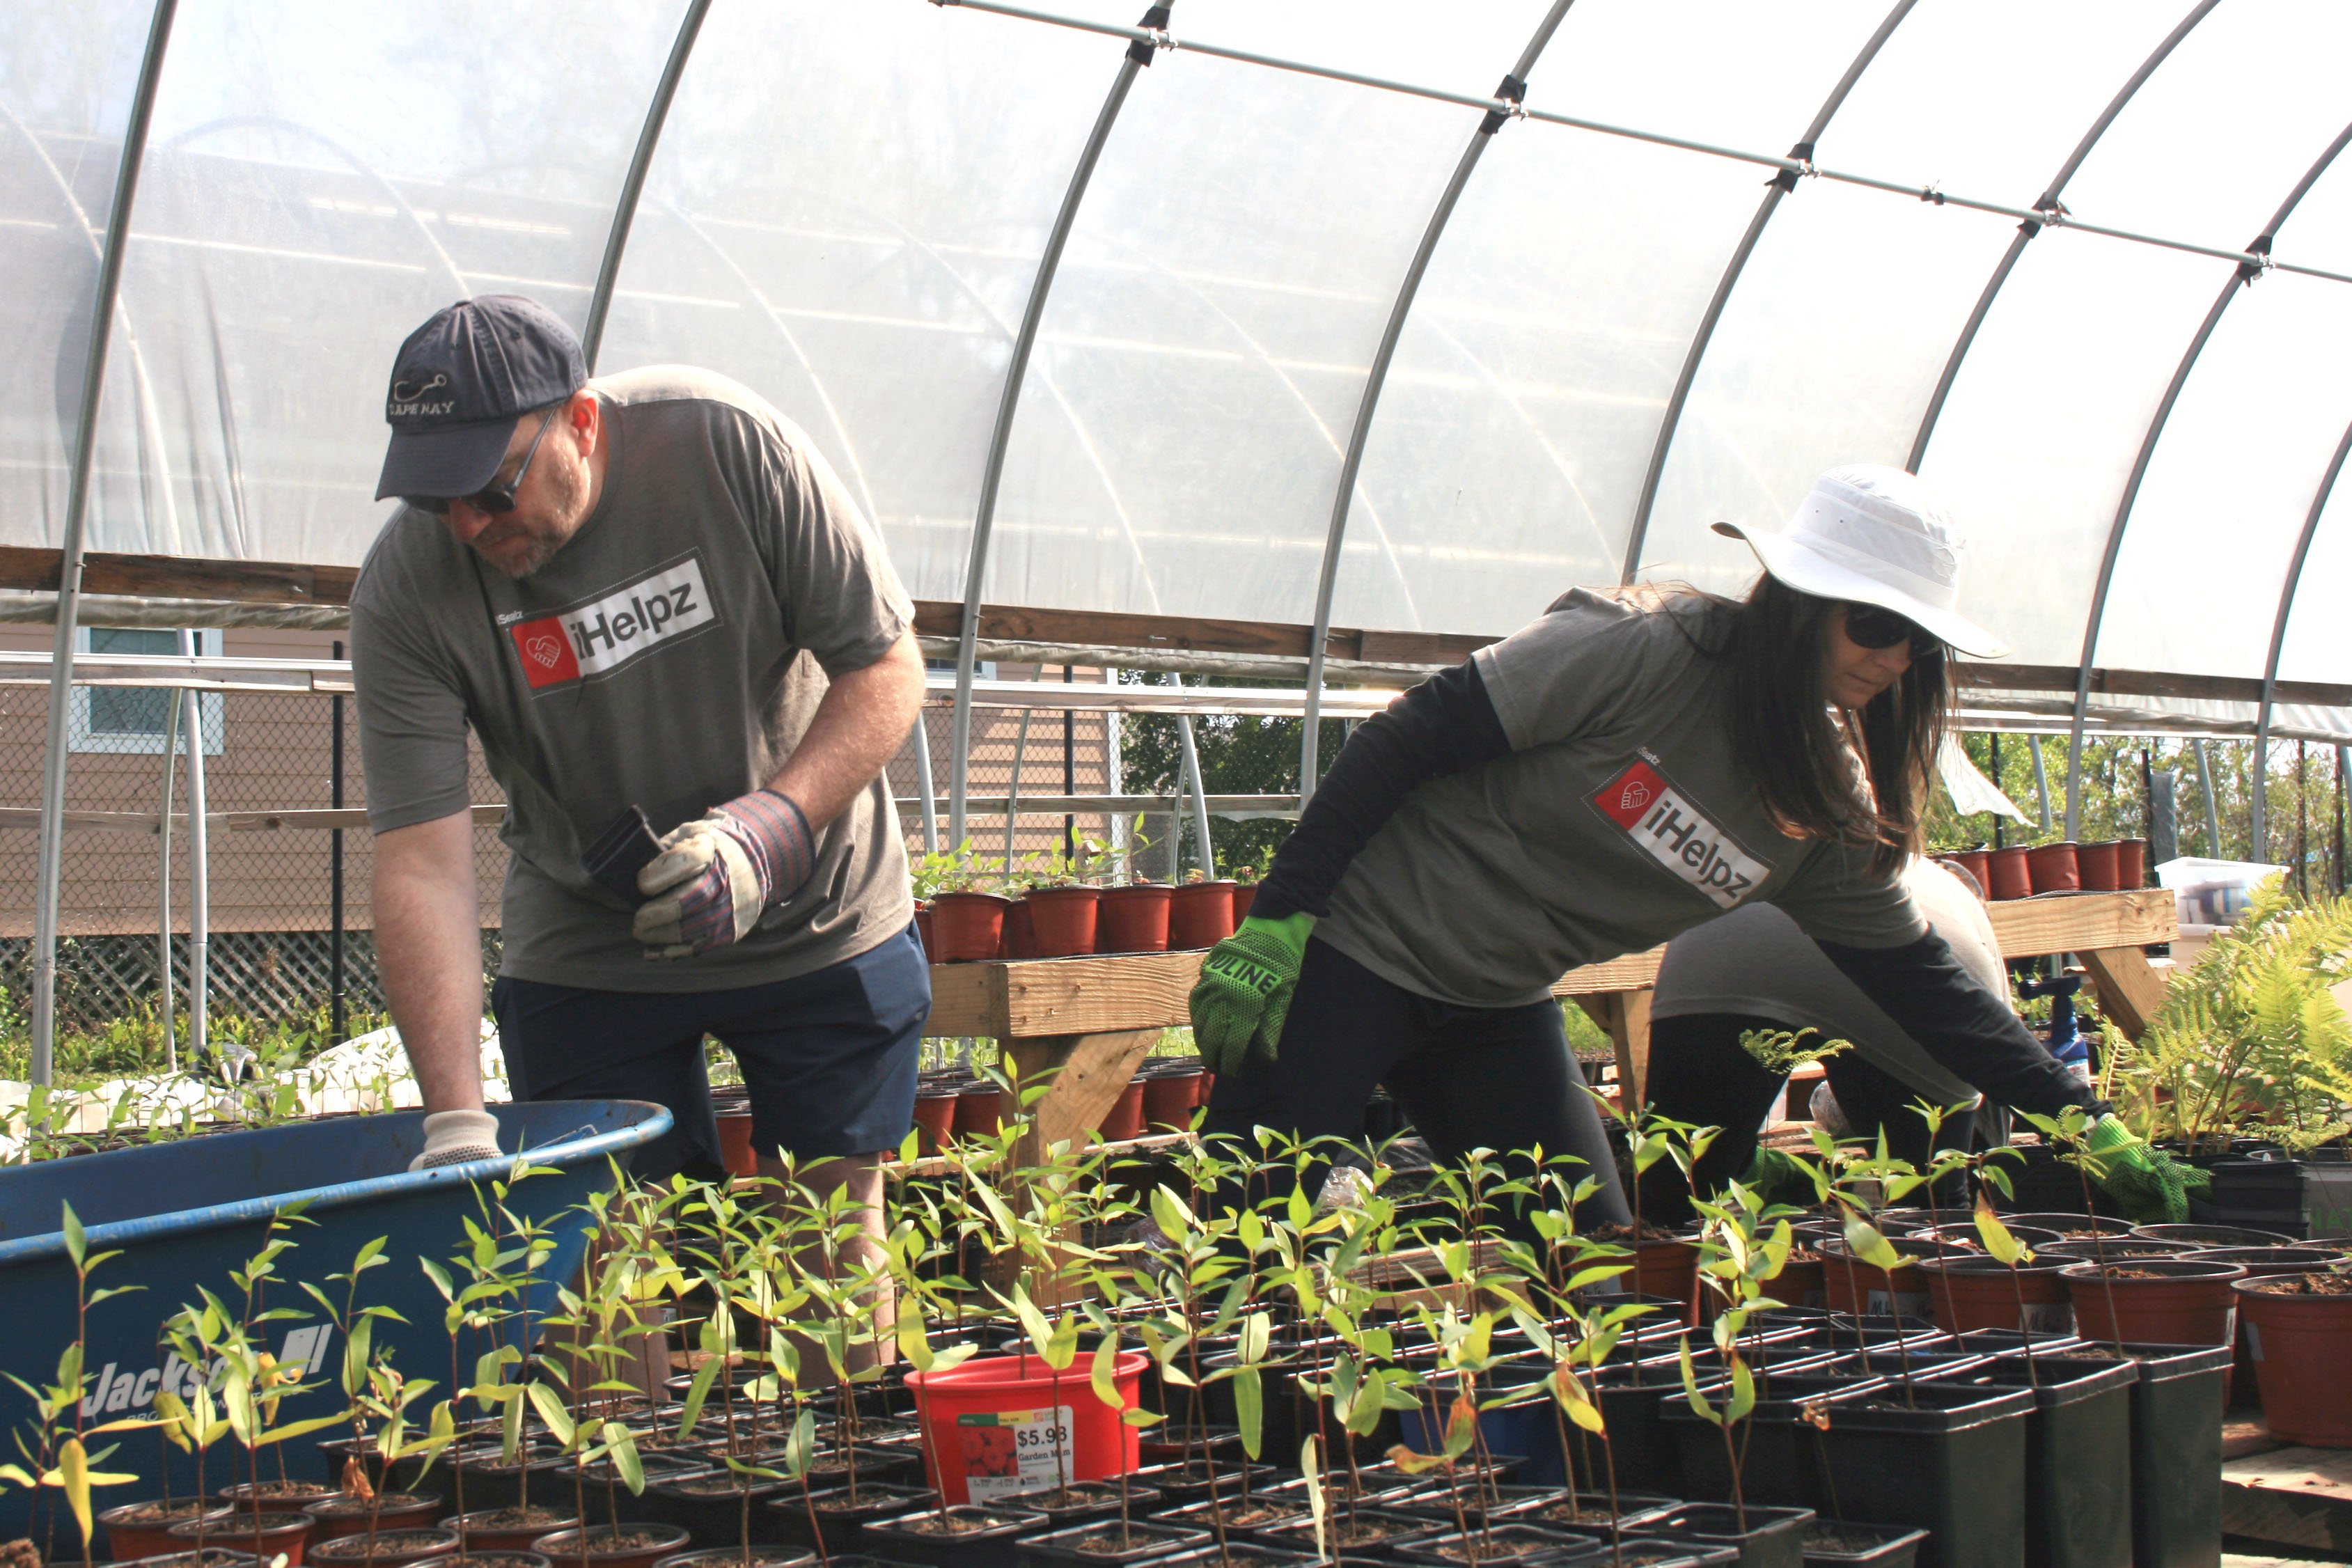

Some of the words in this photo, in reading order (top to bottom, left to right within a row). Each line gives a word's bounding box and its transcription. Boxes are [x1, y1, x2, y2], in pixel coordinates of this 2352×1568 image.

[570, 582, 698, 660] iHelpz
[1644, 800, 1752, 899] iHelpz
[1210, 955, 1278, 994] ULINE
[1019, 1451, 1049, 1461] Garden
[1050, 1449, 1071, 1457] Mm
